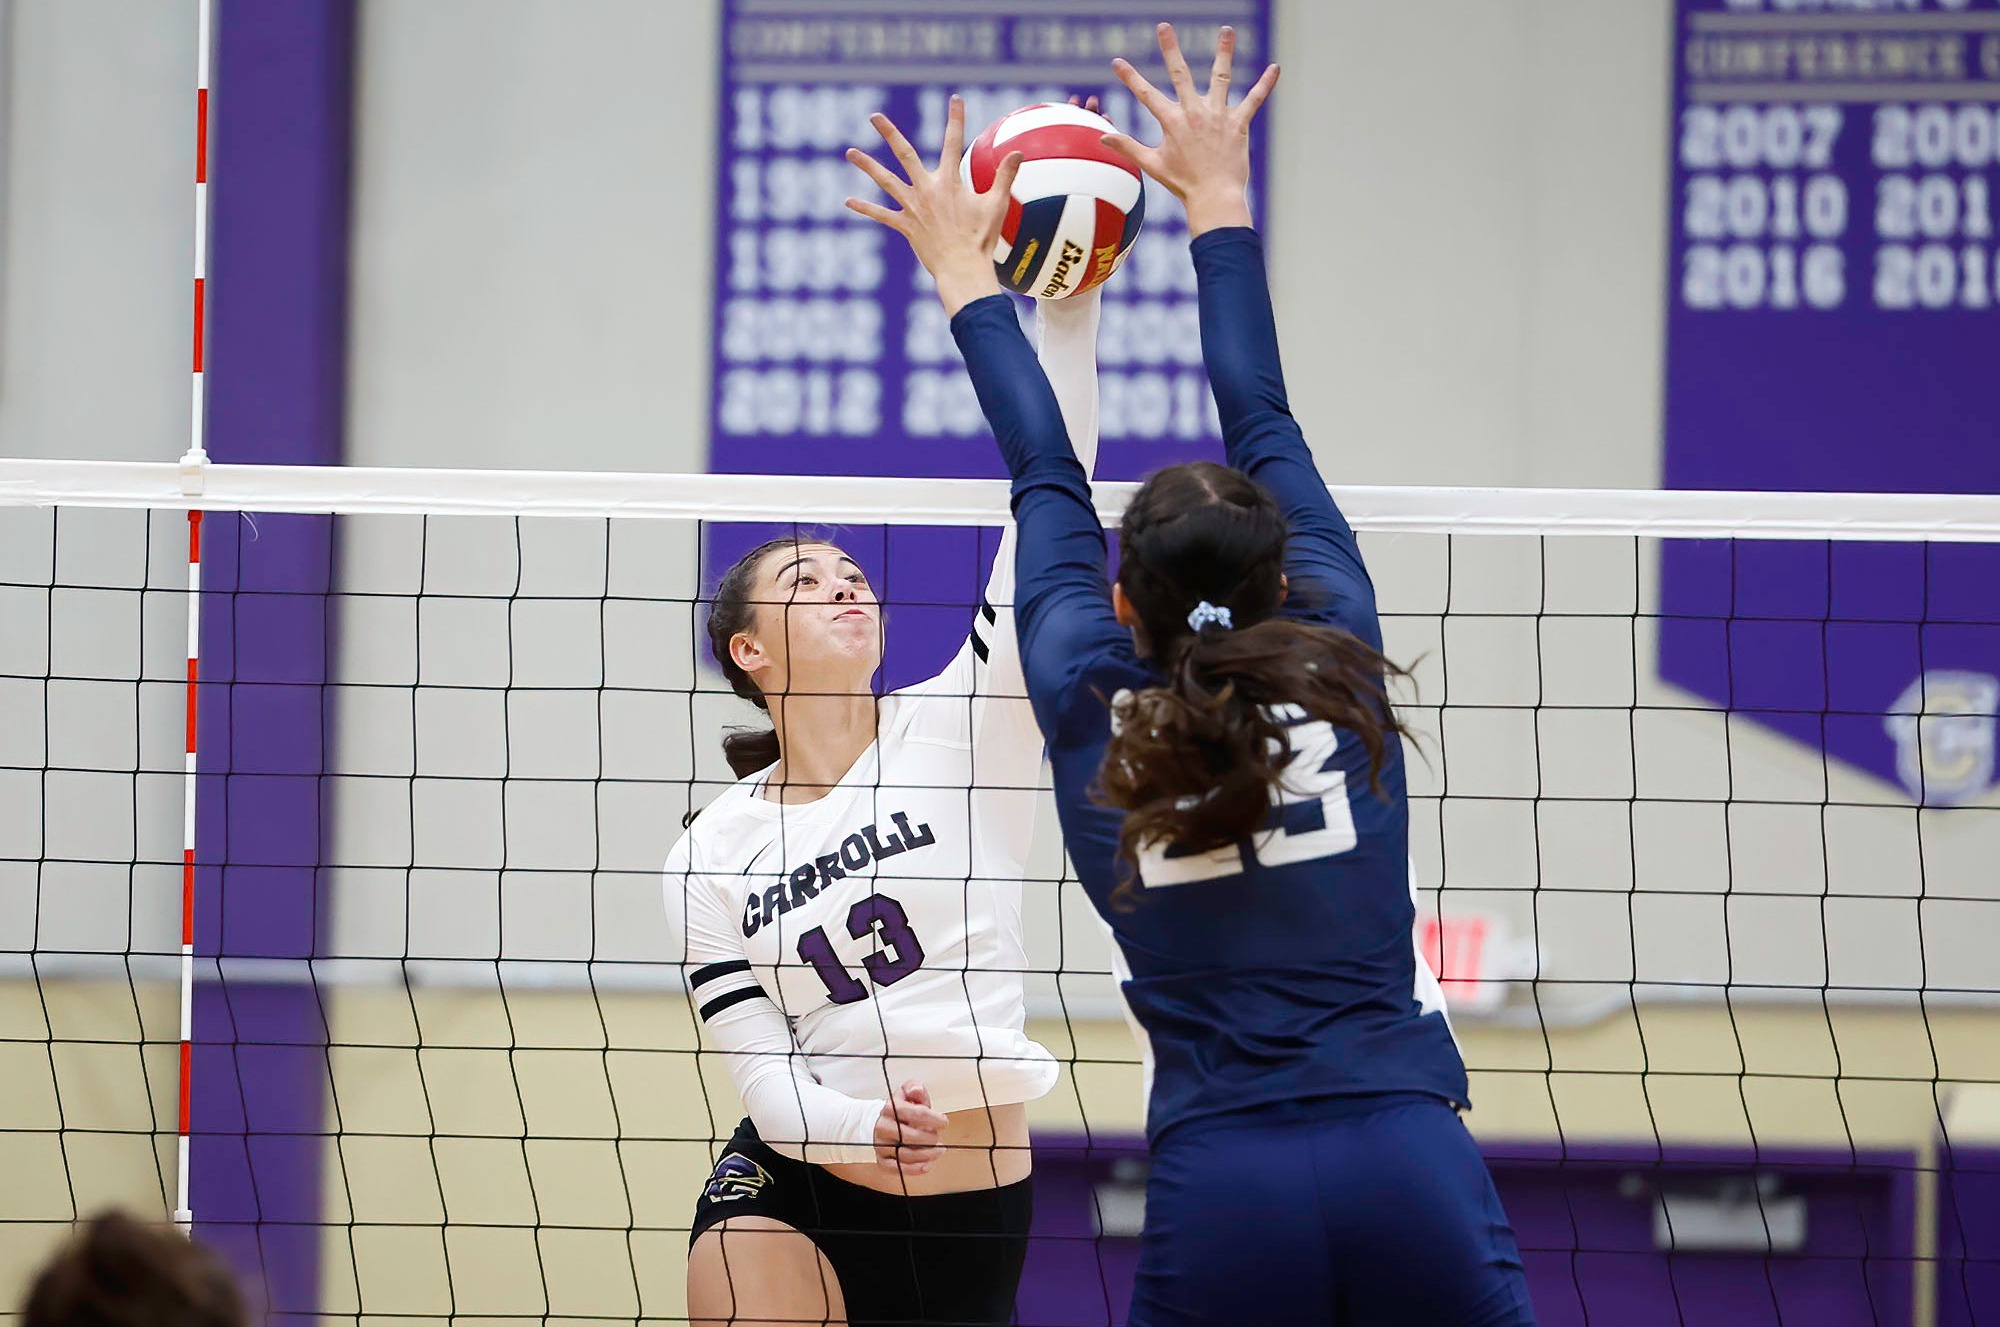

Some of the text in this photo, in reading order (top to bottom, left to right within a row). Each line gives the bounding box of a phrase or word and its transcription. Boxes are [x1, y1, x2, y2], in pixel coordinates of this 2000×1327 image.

[1682, 104, 2000, 168] 2007 200
[1685, 174, 1993, 239] 2010 201
[1041, 240, 1084, 298] Baden
[1684, 243, 2000, 309] 2016 201
[720, 369, 880, 435] 2012
[742, 811, 936, 939] CARROLL
[796, 893, 925, 1005] 13
